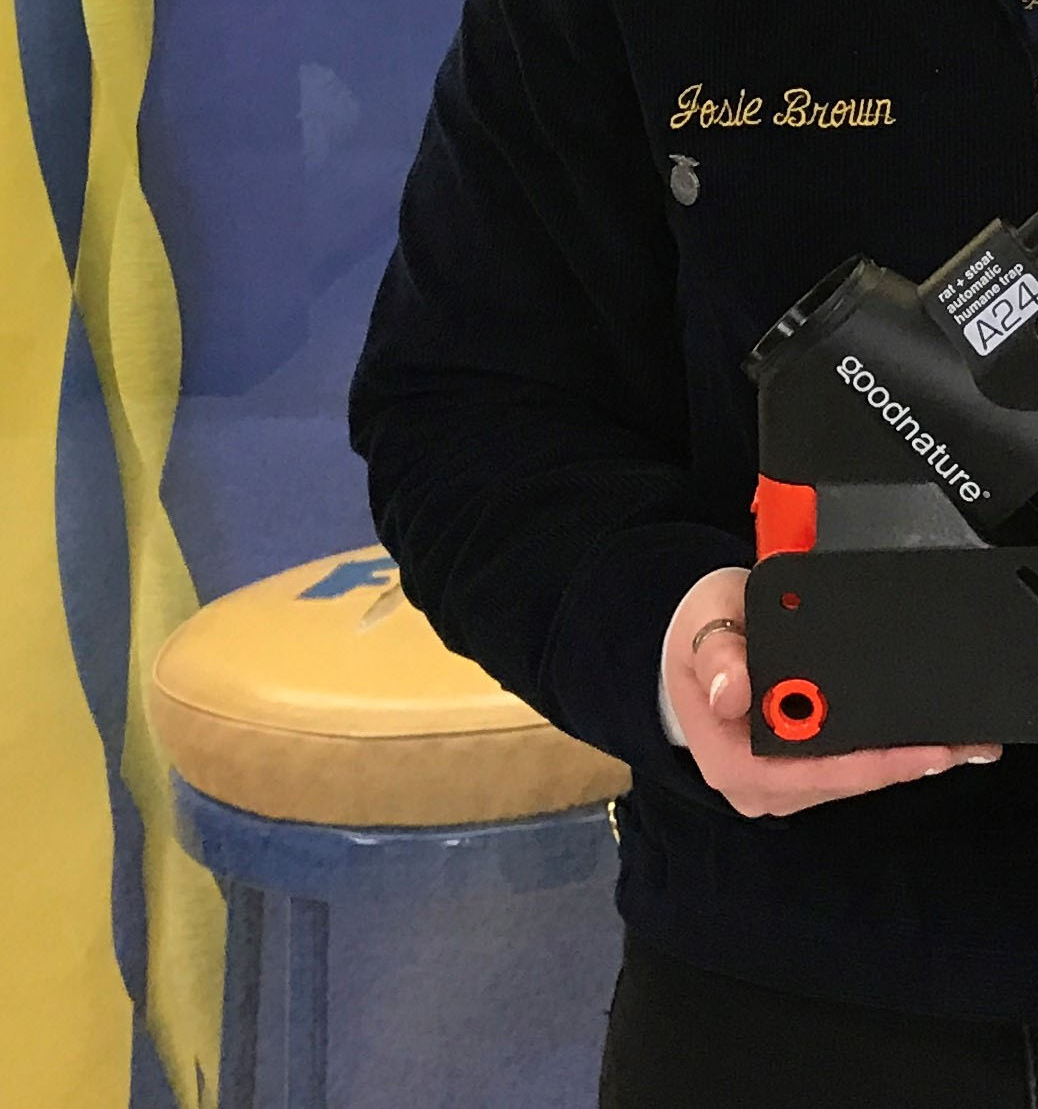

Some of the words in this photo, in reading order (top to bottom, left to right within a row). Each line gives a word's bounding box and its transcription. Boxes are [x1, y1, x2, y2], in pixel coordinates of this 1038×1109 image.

[669, 83, 763, 130] Josie
[773, 88, 897, 129] Brown
[938, 284, 957, 303] rat
[964, 250, 995, 280] stoat
[946, 264, 1002, 314] automatic
[953, 283, 1001, 325] humane
[999, 263, 1024, 286] trap
